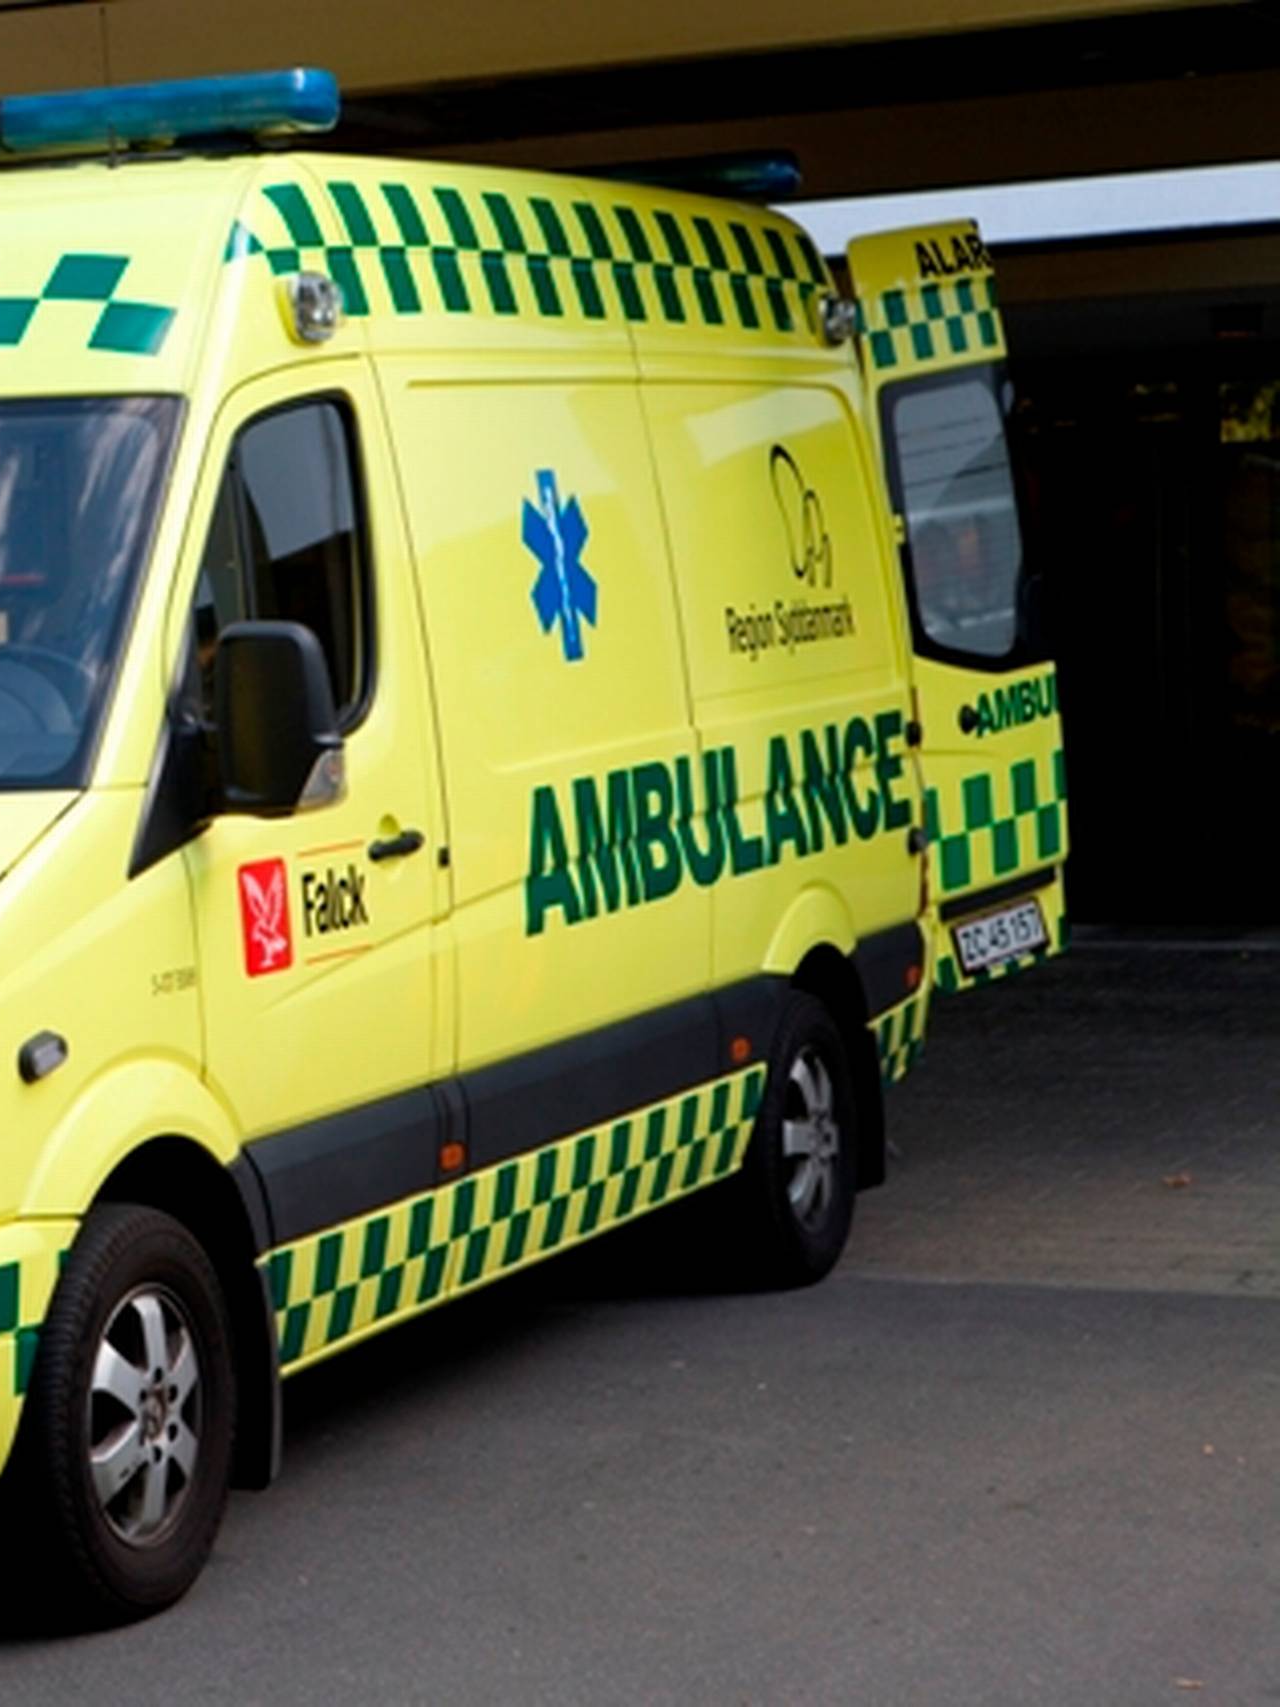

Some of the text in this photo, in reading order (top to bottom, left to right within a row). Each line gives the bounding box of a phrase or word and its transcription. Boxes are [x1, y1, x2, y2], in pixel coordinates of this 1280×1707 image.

[724, 603, 775, 662] Region
[525, 710, 912, 937] AMBULANCE
[302, 864, 368, 937] Falck
[961, 927, 989, 960] ZC
